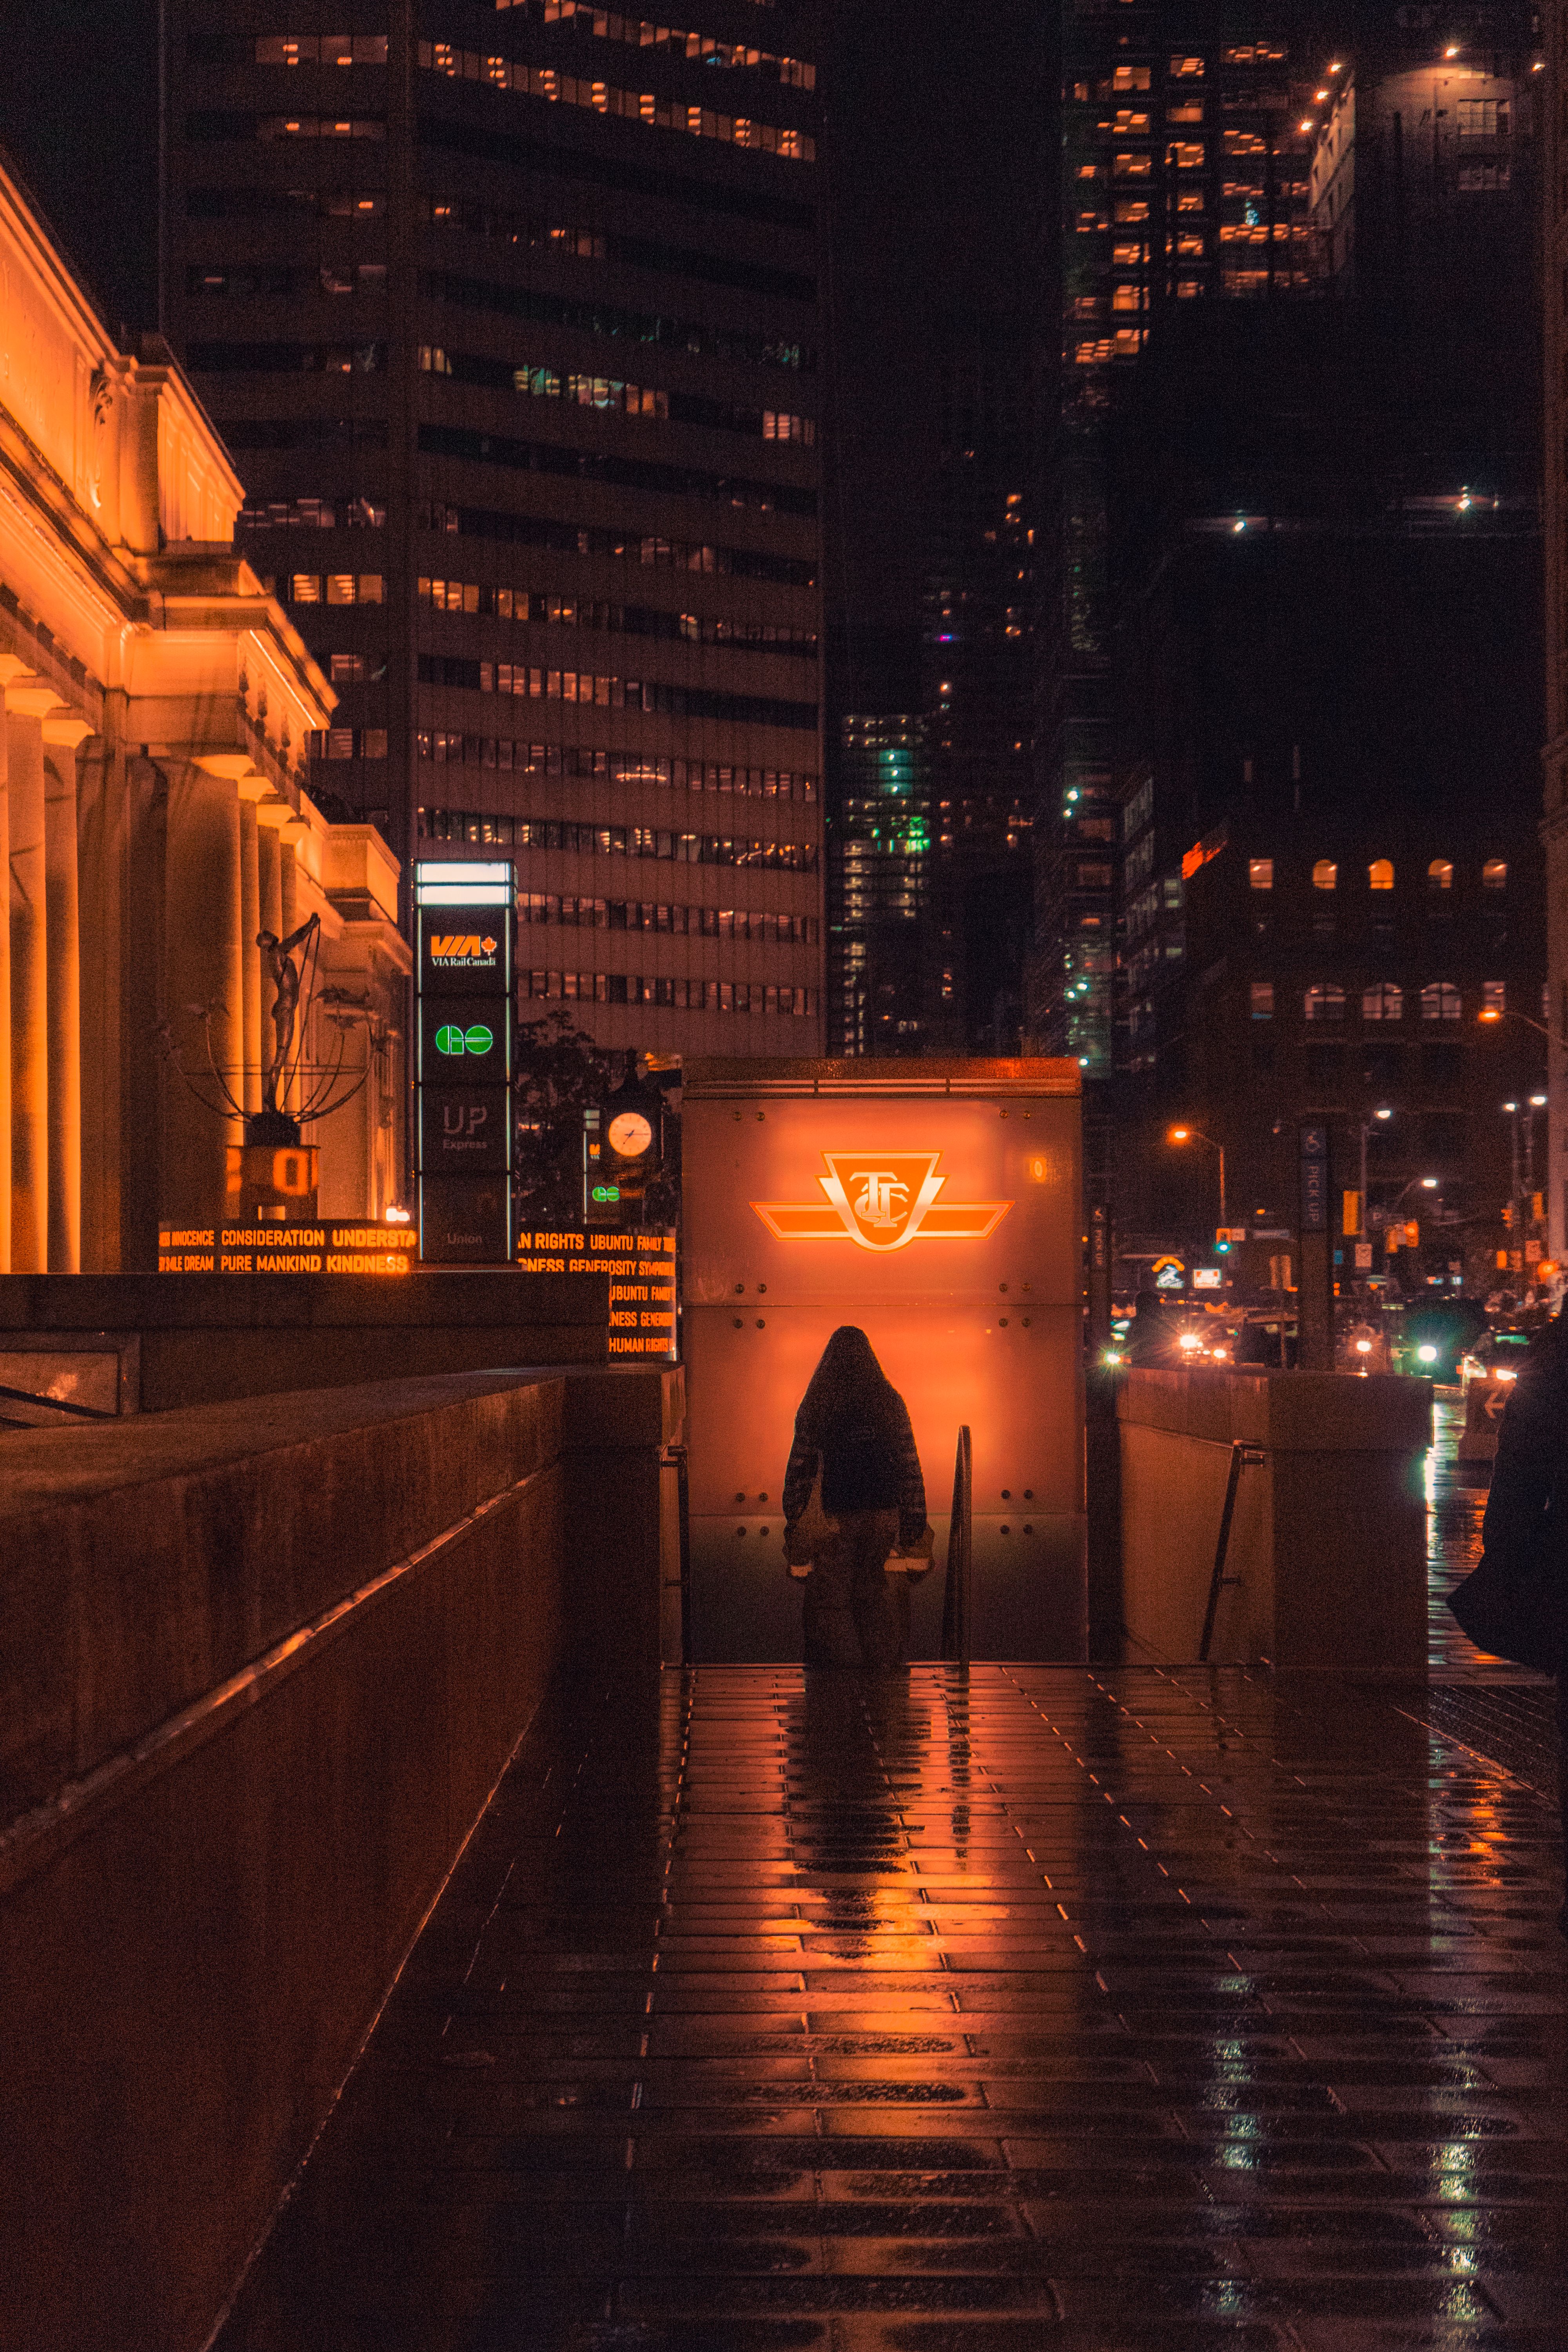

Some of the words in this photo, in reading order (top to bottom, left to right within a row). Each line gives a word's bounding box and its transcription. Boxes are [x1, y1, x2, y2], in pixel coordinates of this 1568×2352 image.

[431, 935, 481, 956] VIA
[432, 957, 449, 966] VIA
[450, 957, 466, 966] Rail
[466, 956, 496, 966] Canada
[436, 1025, 493, 1054] GO
[443, 1106, 487, 1134] UP
[443, 1139, 488, 1150] Express
[849, 1171, 910, 1228] TTC
[172, 1230, 214, 1245] INNOCENCE
[222, 1230, 324, 1246] CONSIDERATION
[518, 1232, 531, 1249] N
[535, 1233, 583, 1249] RIGHTS
[591, 1235, 633, 1250] UBUNTU
[638, 1236, 661, 1250] FAMILY
[447, 1232, 483, 1244] Union
[185, 1256, 213, 1270] DREAM
[221, 1256, 251, 1270] PURE
[257, 1255, 321, 1272] MANKIND
[327, 1254, 407, 1272] KINDNESS
[609, 1312, 637, 1326] NESS
[609, 1338, 644, 1352] HUMAN
